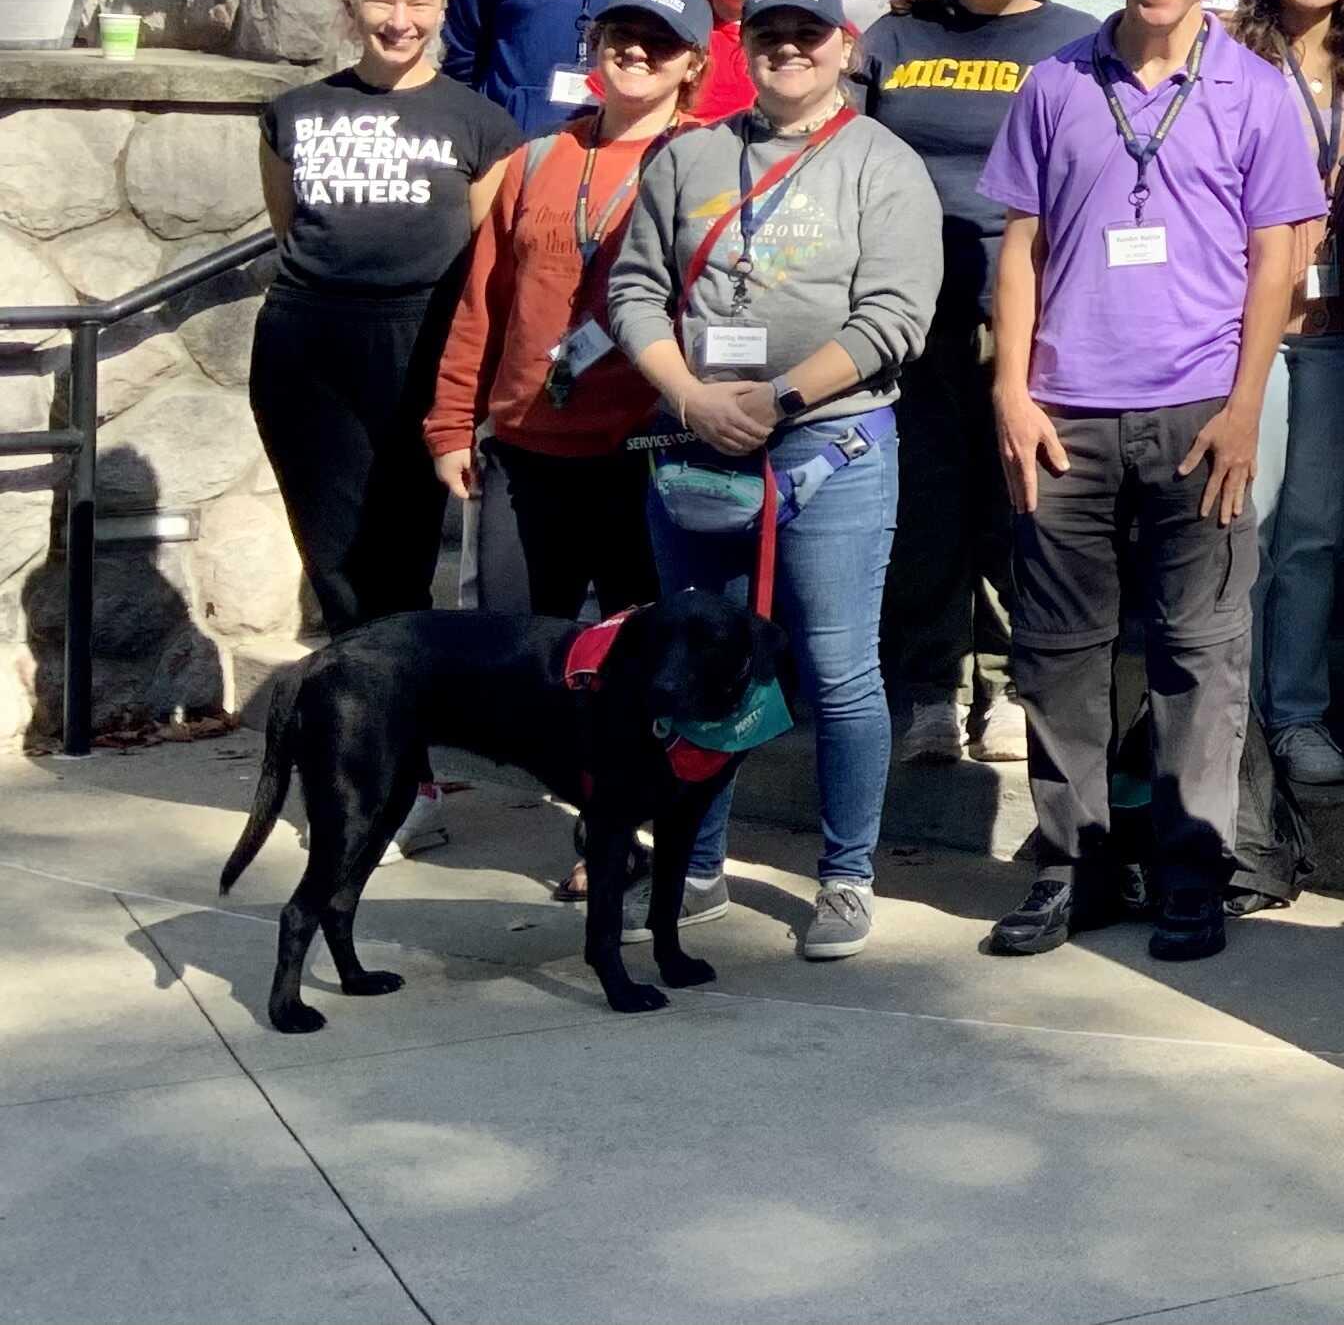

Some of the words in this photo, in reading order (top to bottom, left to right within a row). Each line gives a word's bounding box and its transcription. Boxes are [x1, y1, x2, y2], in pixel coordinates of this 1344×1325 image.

[884, 58, 1034, 93] MICHIG
[295, 115, 401, 141] BLACK
[293, 136, 459, 166] MATERNAL
[626, 434, 674, 451] SERVICE
[679, 431, 698, 444] DO
